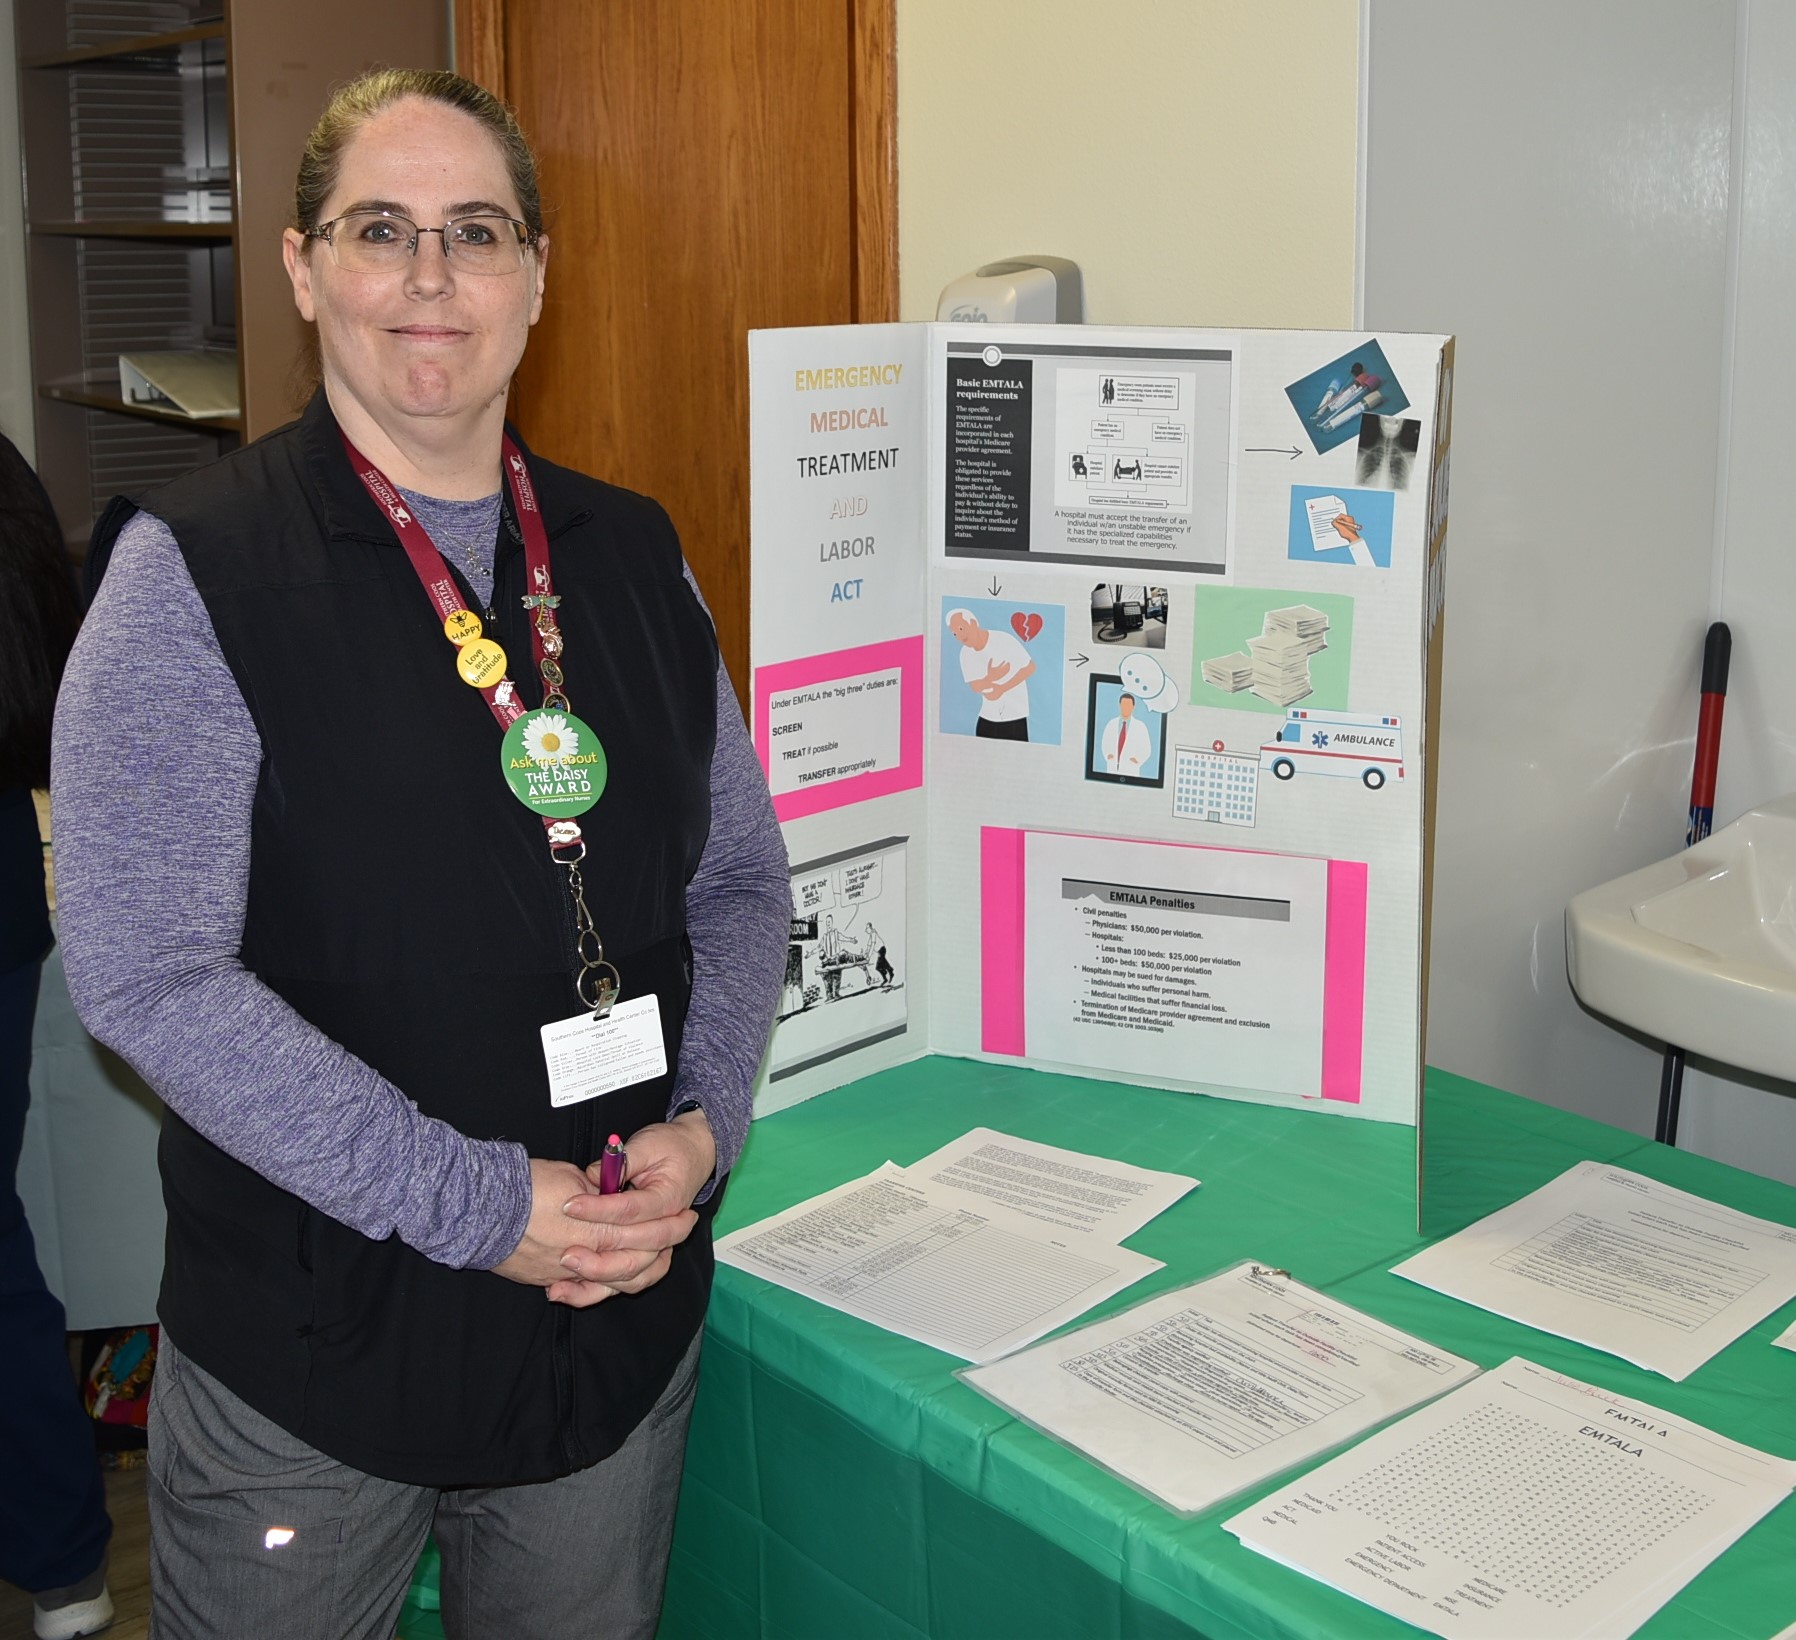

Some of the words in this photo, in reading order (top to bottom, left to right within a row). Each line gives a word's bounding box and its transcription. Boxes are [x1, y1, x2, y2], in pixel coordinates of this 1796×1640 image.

[796, 364, 902, 391] EMERGENCY
[957, 378, 981, 387] Basic
[982, 380, 1023, 389] EMTALA
[956, 391, 1019, 400] requirements
[968, 406, 990, 414] specific
[995, 414, 1002, 422] of
[810, 407, 888, 433] MEDICAL
[797, 448, 899, 478] TREATMENT
[955, 467, 982, 475] obligated
[967, 460, 991, 468] hospital
[365, 469, 394, 505] HOSPITAL
[519, 476, 533, 511] HOSPITAL
[830, 496, 868, 519] AND
[1061, 511, 1087, 519] hospital
[1106, 514, 1128, 522] accept
[1142, 516, 1168, 524] transfer
[1067, 520, 1098, 528] individual
[1148, 526, 1185, 534] emergency
[1067, 537, 1099, 545] necessary
[1139, 542, 1178, 550] emergency.
[1136, 533, 1173, 541] capabilities
[820, 537, 875, 562] LABOR
[831, 579, 863, 602] ACT
[451, 624, 481, 640] HAPPY
[465, 648, 483, 665] Love
[475, 654, 488, 669] and
[472, 653, 503, 684] Gratitude
[771, 700, 791, 710] Under
[792, 692, 821, 705] EMTALA
[822, 691, 832, 699] the
[834, 688, 846, 697] "big
[847, 683, 866, 693] three"
[866, 681, 885, 690] duties
[886, 678, 898, 687] are:
[772, 722, 803, 736] SCREEN
[1334, 734, 1395, 748] AMBULANCE
[783, 748, 806, 760] TREAT
[807, 746, 811, 755] if
[812, 742, 839, 755] possible
[1195, 755, 1238, 764] HOSPITAL
[510, 756, 533, 769] Ask
[536, 757, 557, 766] me
[560, 752, 598, 765] about
[525, 771, 550, 783] THE
[554, 769, 588, 781] DAISY
[799, 767, 836, 782] TRANSFER
[837, 759, 876, 774] appropriately
[529, 782, 591, 796] AWARD
[541, 796, 573, 805] Extraordinary
[1110, 892, 1147, 904] EMTALA
[1150, 896, 1195, 909] Penalties
[1083, 907, 1097, 915] Civil
[1097, 910, 1127, 919] penalties
[1092, 920, 1128, 931] Physicians:
[1131, 925, 1160, 934] $50,000
[1173, 930, 1204, 939] violation.
[1092, 932, 1124, 942] Hospitals:
[1101, 944, 1116, 953] Less
[1117, 946, 1132, 955] than
[1133, 948, 1146, 956] 100
[1147, 950, 1166, 958] beds:
[1169, 952, 1199, 962] $25,000
[1212, 958, 1241, 966] violation
[1102, 956, 1118, 964] 100+
[1120, 958, 1138, 967] beds:
[1141, 961, 1170, 971] $50,000
[1183, 966, 1212, 975] violation
[1082, 965, 1112, 975] Hospitals
[1113, 970, 1126, 978] may
[1154, 974, 1164, 982] for
[1164, 976, 1197, 986] damages.
[1091, 978, 1126, 989] Individuals
[1141, 985, 1161, 993] suffer
[1162, 988, 1191, 996] personal
[1192, 990, 1211, 999] harm.
[1091, 990, 1117, 999] Medical
[1118, 993, 1146, 1003] facilities
[1146, 997, 1160, 1005] that
[1161, 999, 1180, 1007] suffer
[1181, 1001, 1211, 1010] financial
[1212, 1004, 1227, 1012] loss.
[1081, 1000, 1119, 1011] Termination
[1127, 1006, 1158, 1016] Medicare
[1159, 1011, 1186, 1019] provider
[1187, 1014, 1223, 1024] agreement
[1238, 1020, 1271, 1029] exclusion
[1081, 1009, 1096, 1017] from
[1097, 1011, 1128, 1021] Medicare
[1142, 1017, 1175, 1027] Medicaid.
[1578, 1426, 1643, 1457] EMTALA
[1292, 1499, 1322, 1514] MEDICAID
[1303, 1493, 1324, 1505] THANK
[1325, 1503, 1338, 1512] YOU
[1272, 1510, 1298, 1525] MEDICAL
[1365, 1546, 1389, 1560] ACTIVE
[1388, 1558, 1411, 1572] LABOR
[1345, 1557, 1384, 1580] EMERGENCY
[1384, 1578, 1427, 1600] DEPARTMENT
